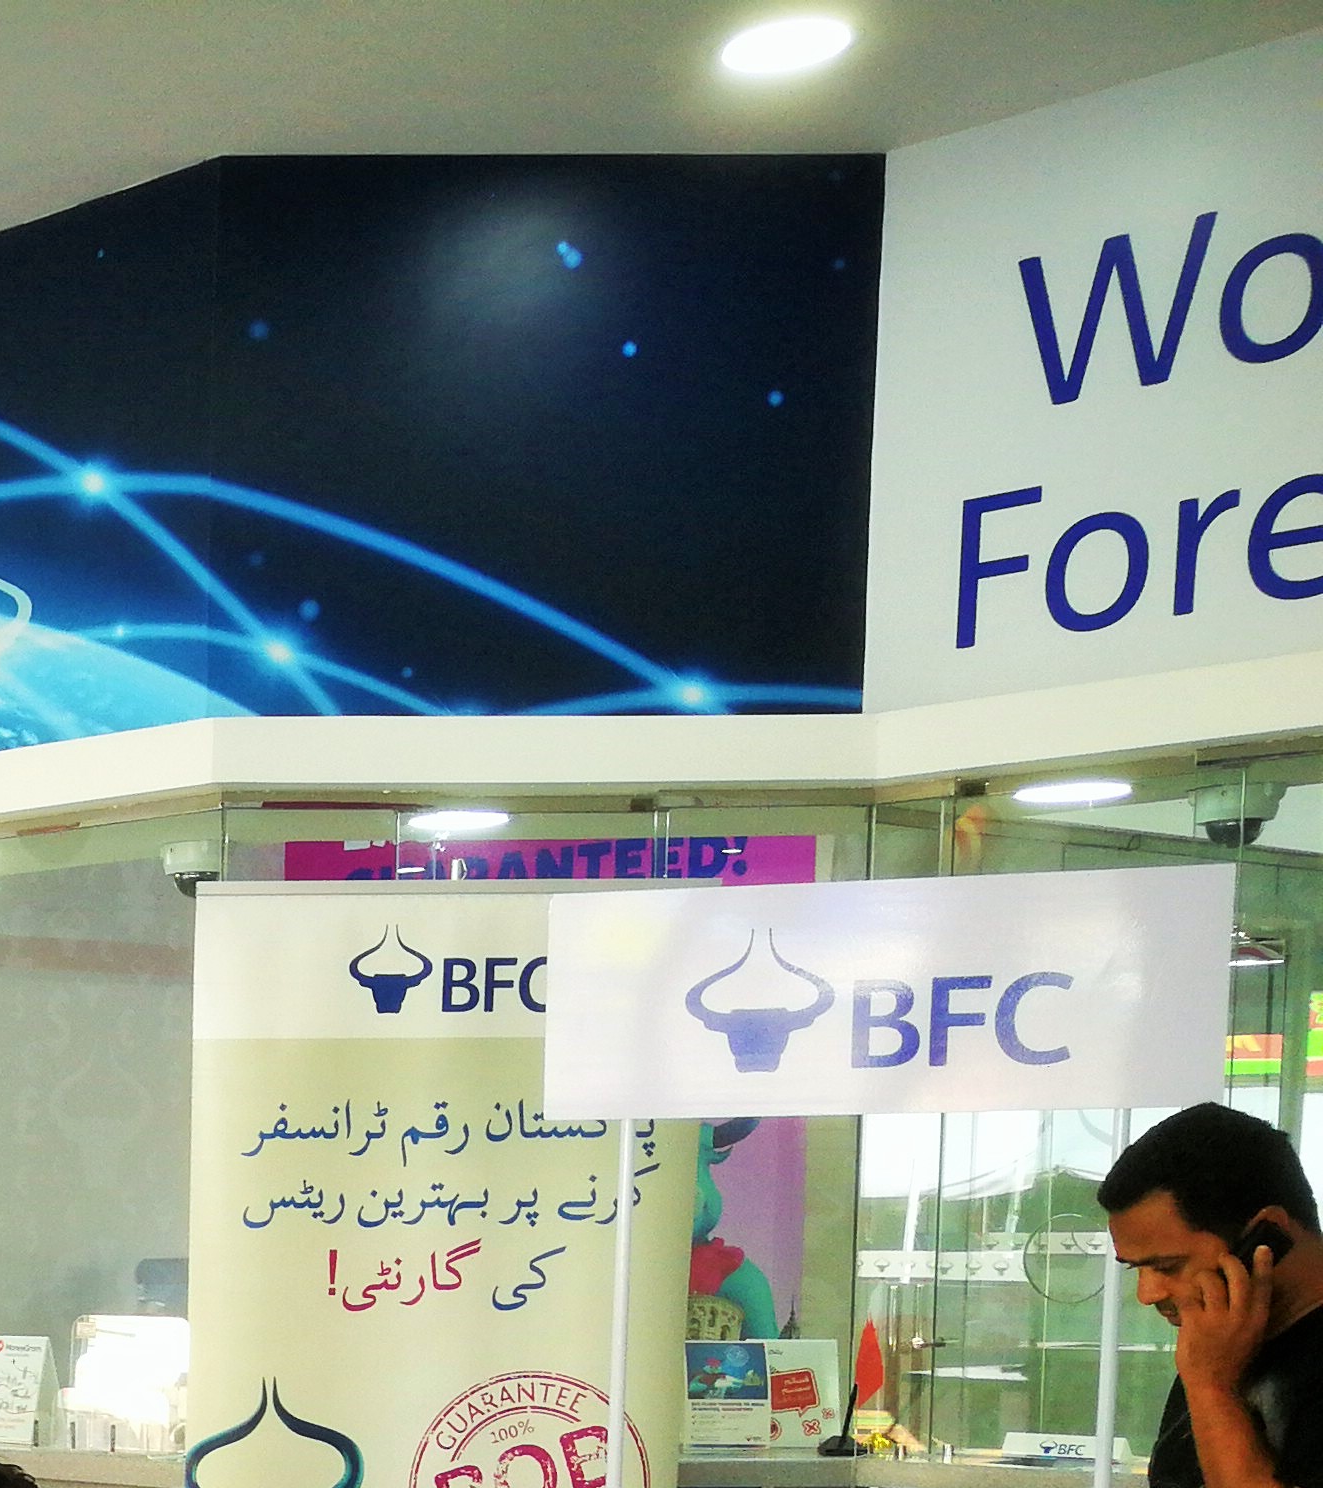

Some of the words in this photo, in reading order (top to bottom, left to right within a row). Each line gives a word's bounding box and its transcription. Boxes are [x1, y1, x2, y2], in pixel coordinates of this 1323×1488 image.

[1018, 211, 1323, 405] Wo
[956, 473, 1323, 649] Fore
[345, 836, 748, 880] ARANTEED!
[850, 970, 1075, 1070] BFC
[241, 1098, 388, 1157] ٹرانسفر
[401, 1099, 470, 1167] رقم
[243, 1179, 345, 1229] ریٹس
[356, 1182, 489, 1227] بہترین
[498, 1187, 539, 1227] پر
[326, 1237, 483, 1312] گارنٹی!
[491, 1246, 568, 1311] کی
[435, 1382, 588, 1451] GUARANTEE
[489, 1418, 535, 1445] 100%
[1057, 1443, 1086, 1457] BFC
